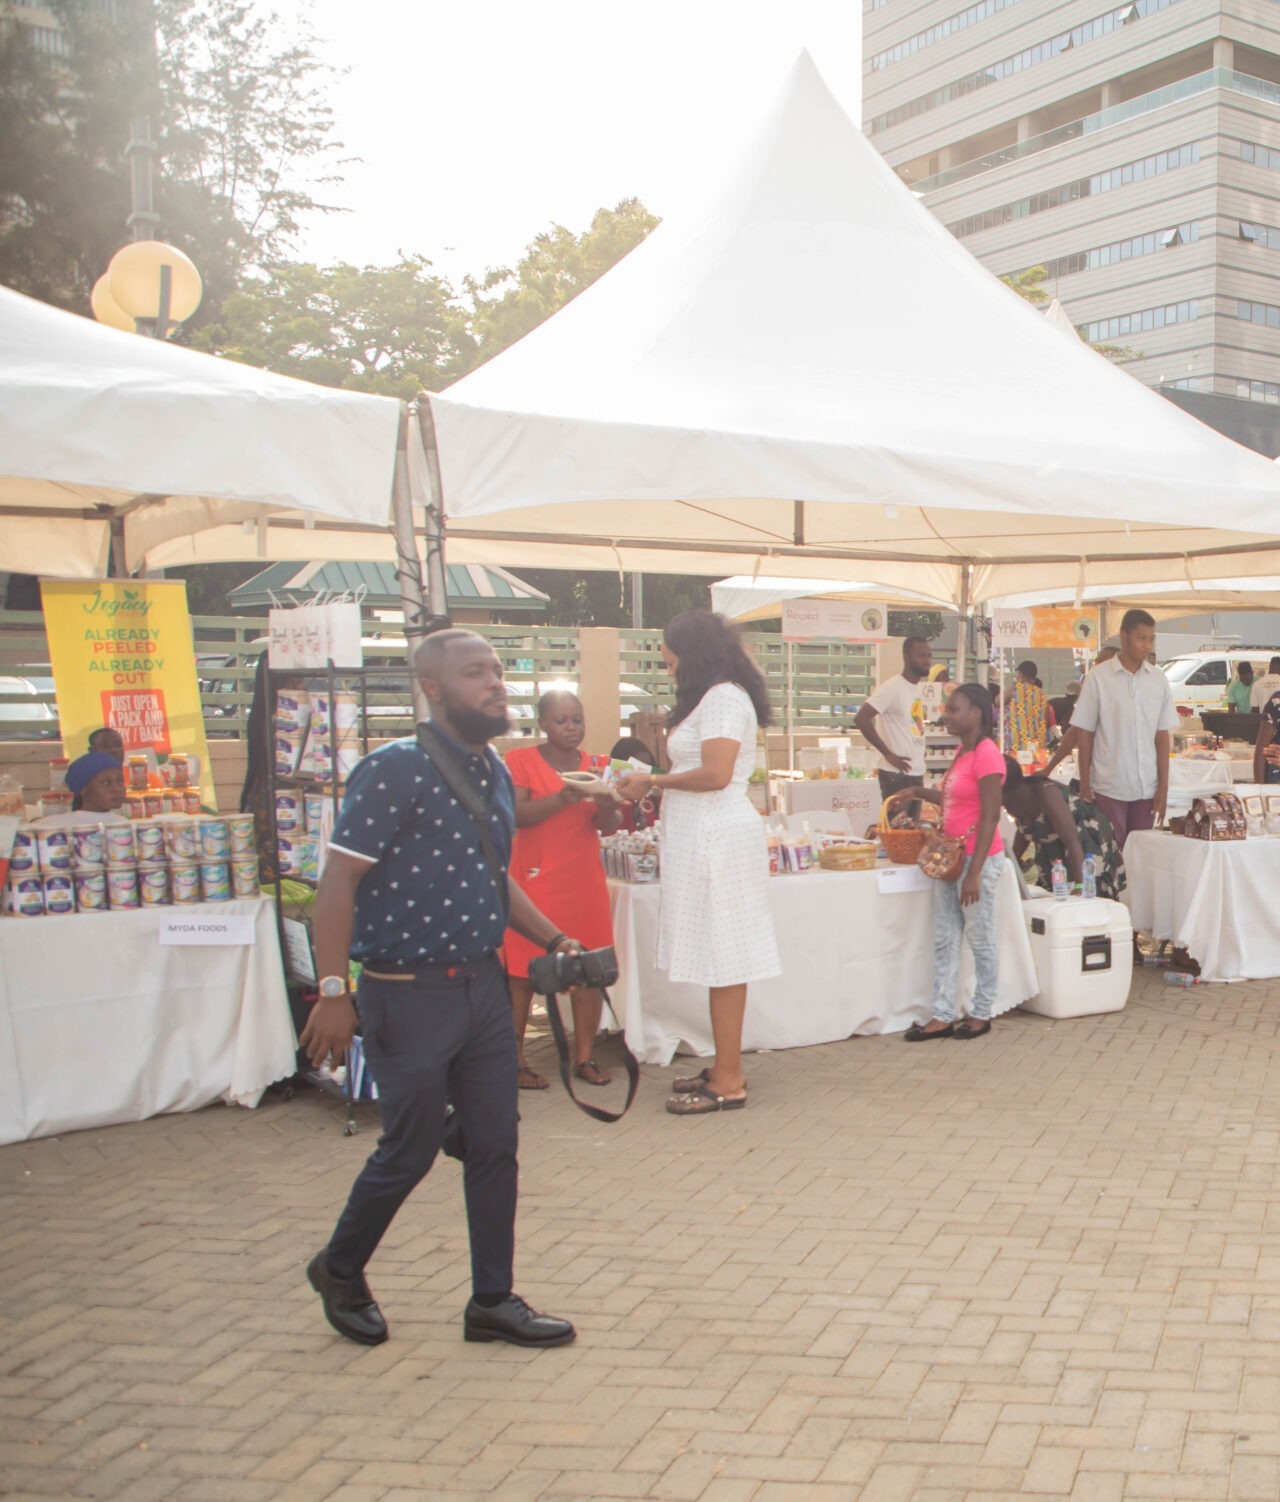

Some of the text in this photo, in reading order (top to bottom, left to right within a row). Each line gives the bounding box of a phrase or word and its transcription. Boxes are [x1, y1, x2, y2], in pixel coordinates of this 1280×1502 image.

[82, 589, 153, 617] Legacy
[997, 620, 1028, 634] YAKA
[84, 628, 160, 641] ALREADY
[93, 641, 157, 654] PEELED
[89, 659, 165, 672] ALREADY
[112, 672, 147, 685] CUT
[110, 694, 159, 711] JUST OPEN
[118, 710, 143, 728] PACK
[144, 710, 164, 727] AND
[140, 726, 165, 742] BAKE
[832, 797, 870, 812] Respect
[168, 924, 228, 932] MYDA FOODS
